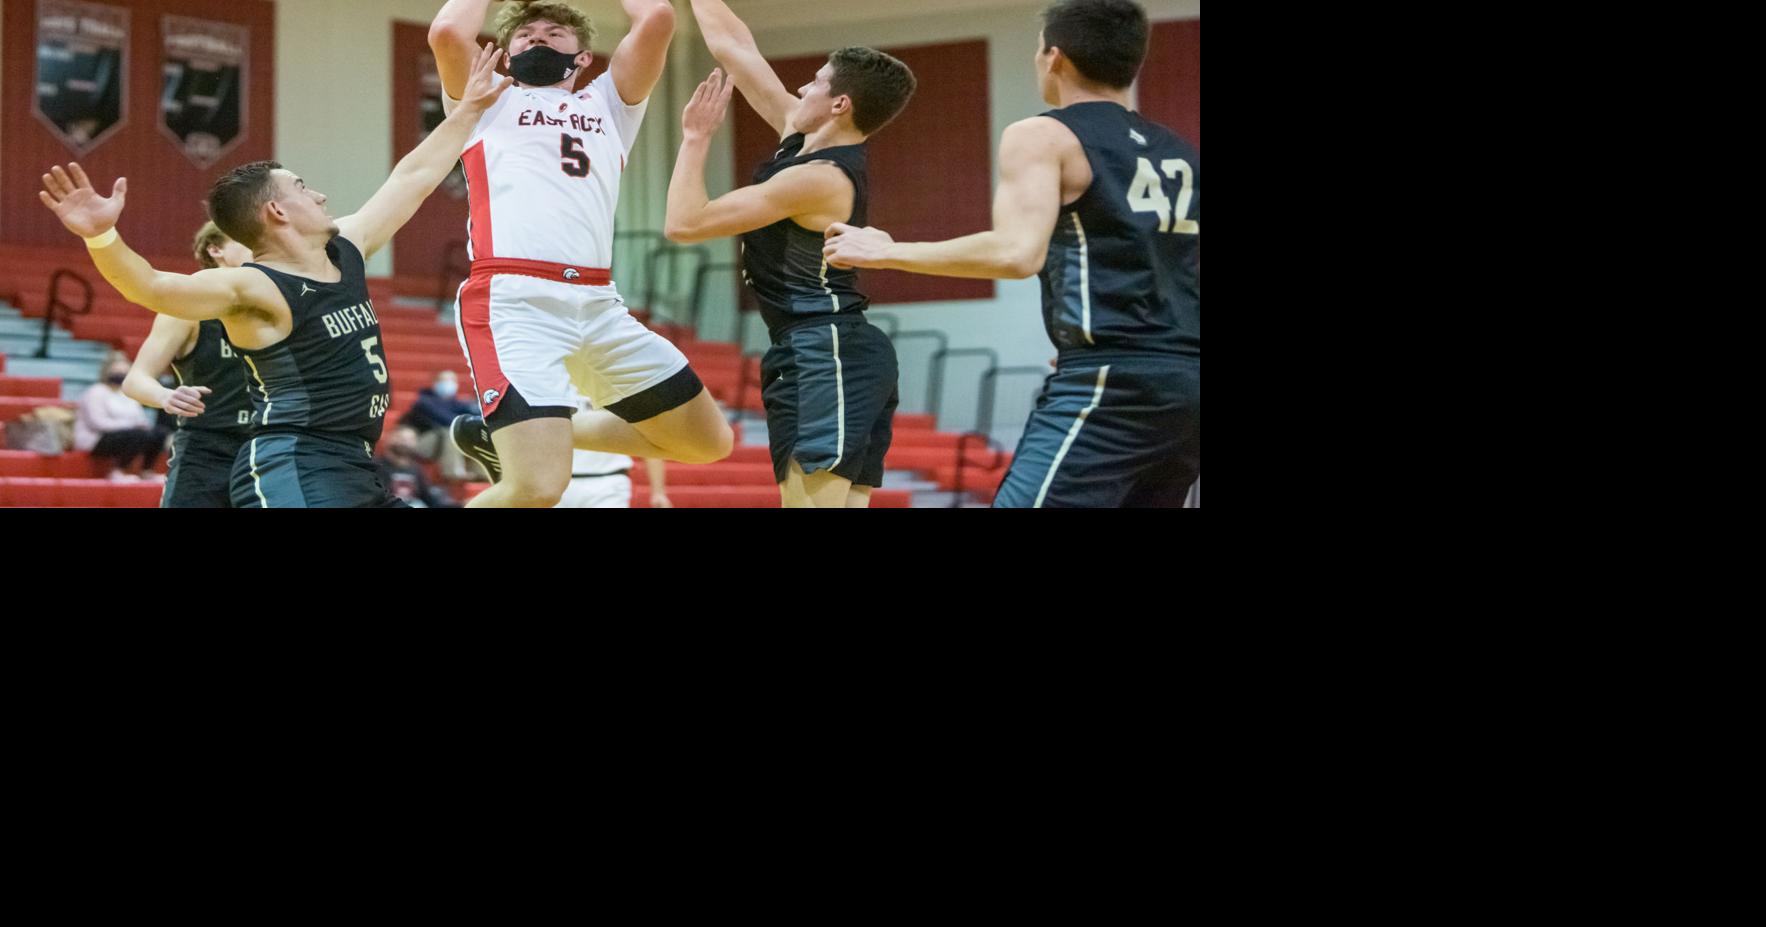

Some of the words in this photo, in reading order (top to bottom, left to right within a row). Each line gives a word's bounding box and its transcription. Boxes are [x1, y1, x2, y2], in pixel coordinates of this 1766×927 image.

[518, 109, 567, 127] EAST
[560, 132, 591, 178] 5
[1126, 156, 1199, 235] 42
[360, 336, 388, 384] 5
